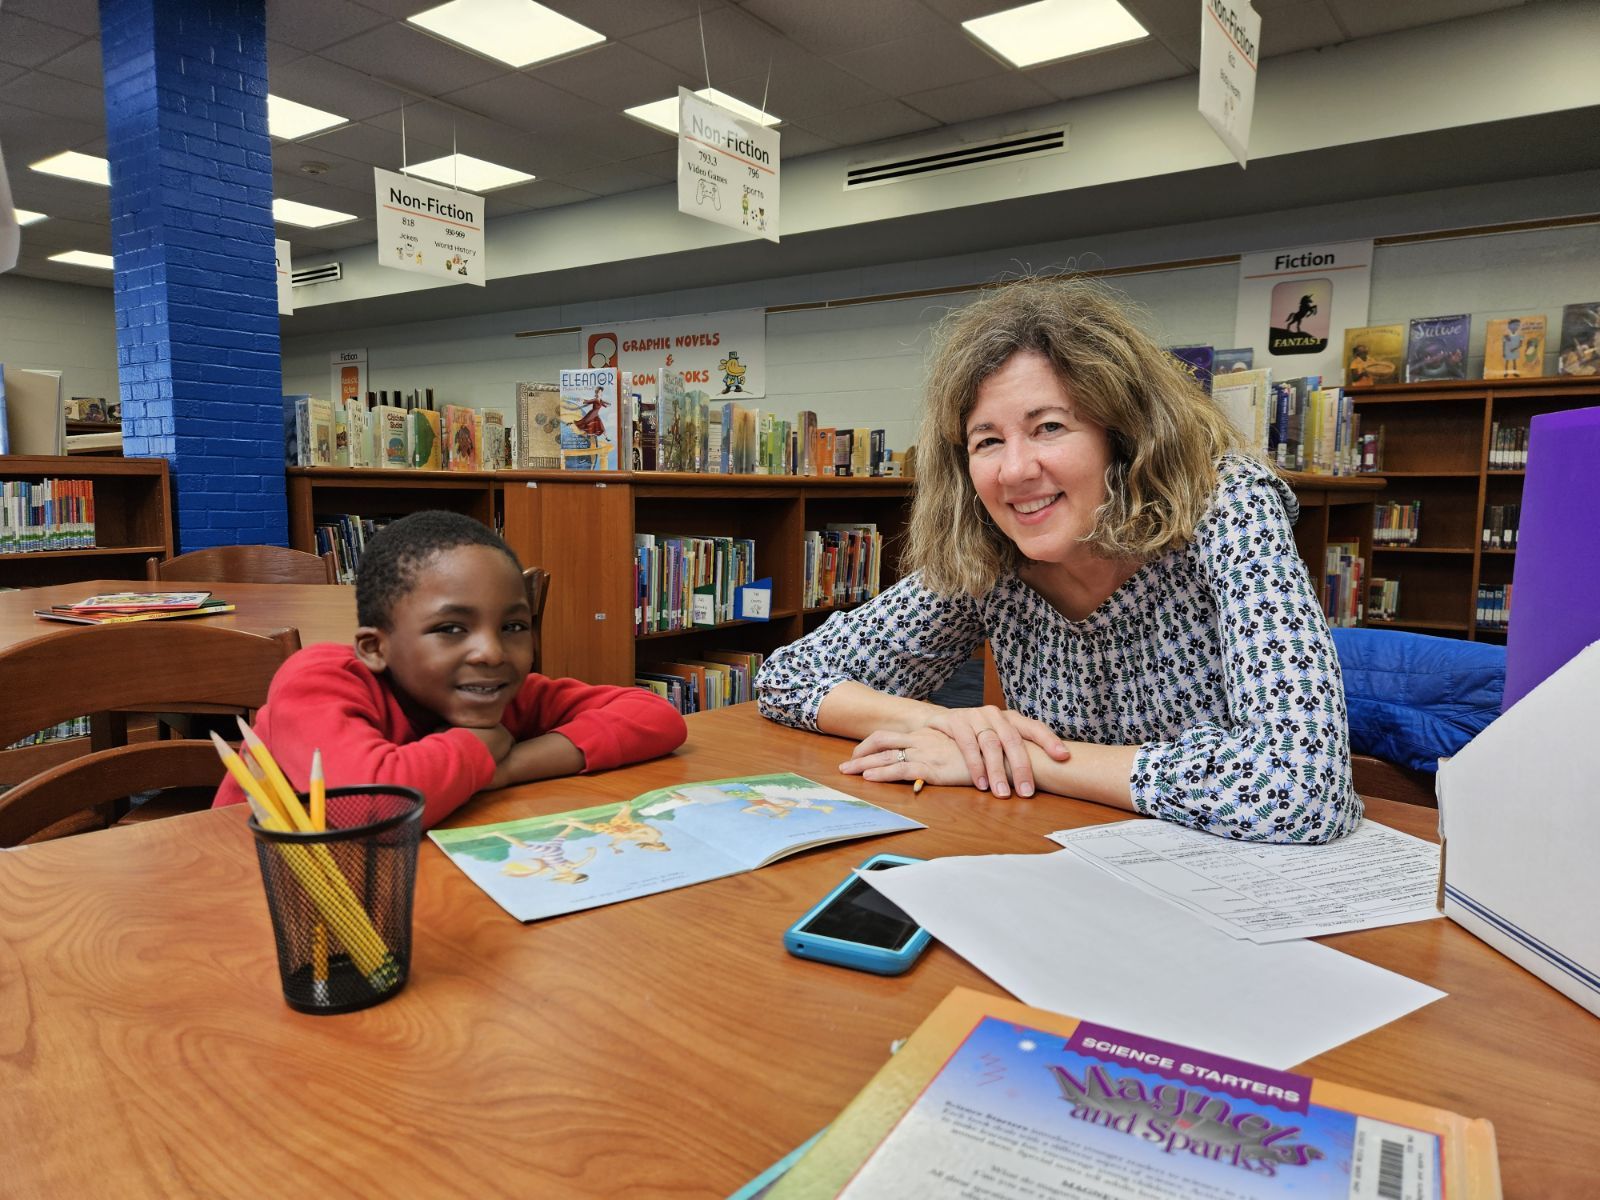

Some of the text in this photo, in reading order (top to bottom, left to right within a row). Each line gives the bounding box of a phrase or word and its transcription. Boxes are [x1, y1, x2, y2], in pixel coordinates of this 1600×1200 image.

[692, 114, 770, 165] Non-Fiction
[698, 150, 718, 167] 793.3
[687, 161, 728, 185] Video Games
[747, 166, 760, 179] 796
[390, 187, 474, 223] Non-Fiction
[402, 217, 415, 228] 818
[434, 241, 477, 257] World History
[1275, 252, 1336, 271] Fiction
[1415, 324, 1463, 339] Sulwe
[622, 332, 721, 353] GRAPHIC NOVELS
[1273, 336, 1323, 348] FANTASY
[340, 352, 358, 361] Fiction
[665, 354, 675, 367] &
[562, 372, 614, 387] ELEANOR
[632, 373, 656, 386] COM
[1081, 1036, 1301, 1104] SCIENCE STARTERS
[1050, 1063, 1328, 1168] Magnets
[1069, 1102, 1278, 1178] and Sparks
